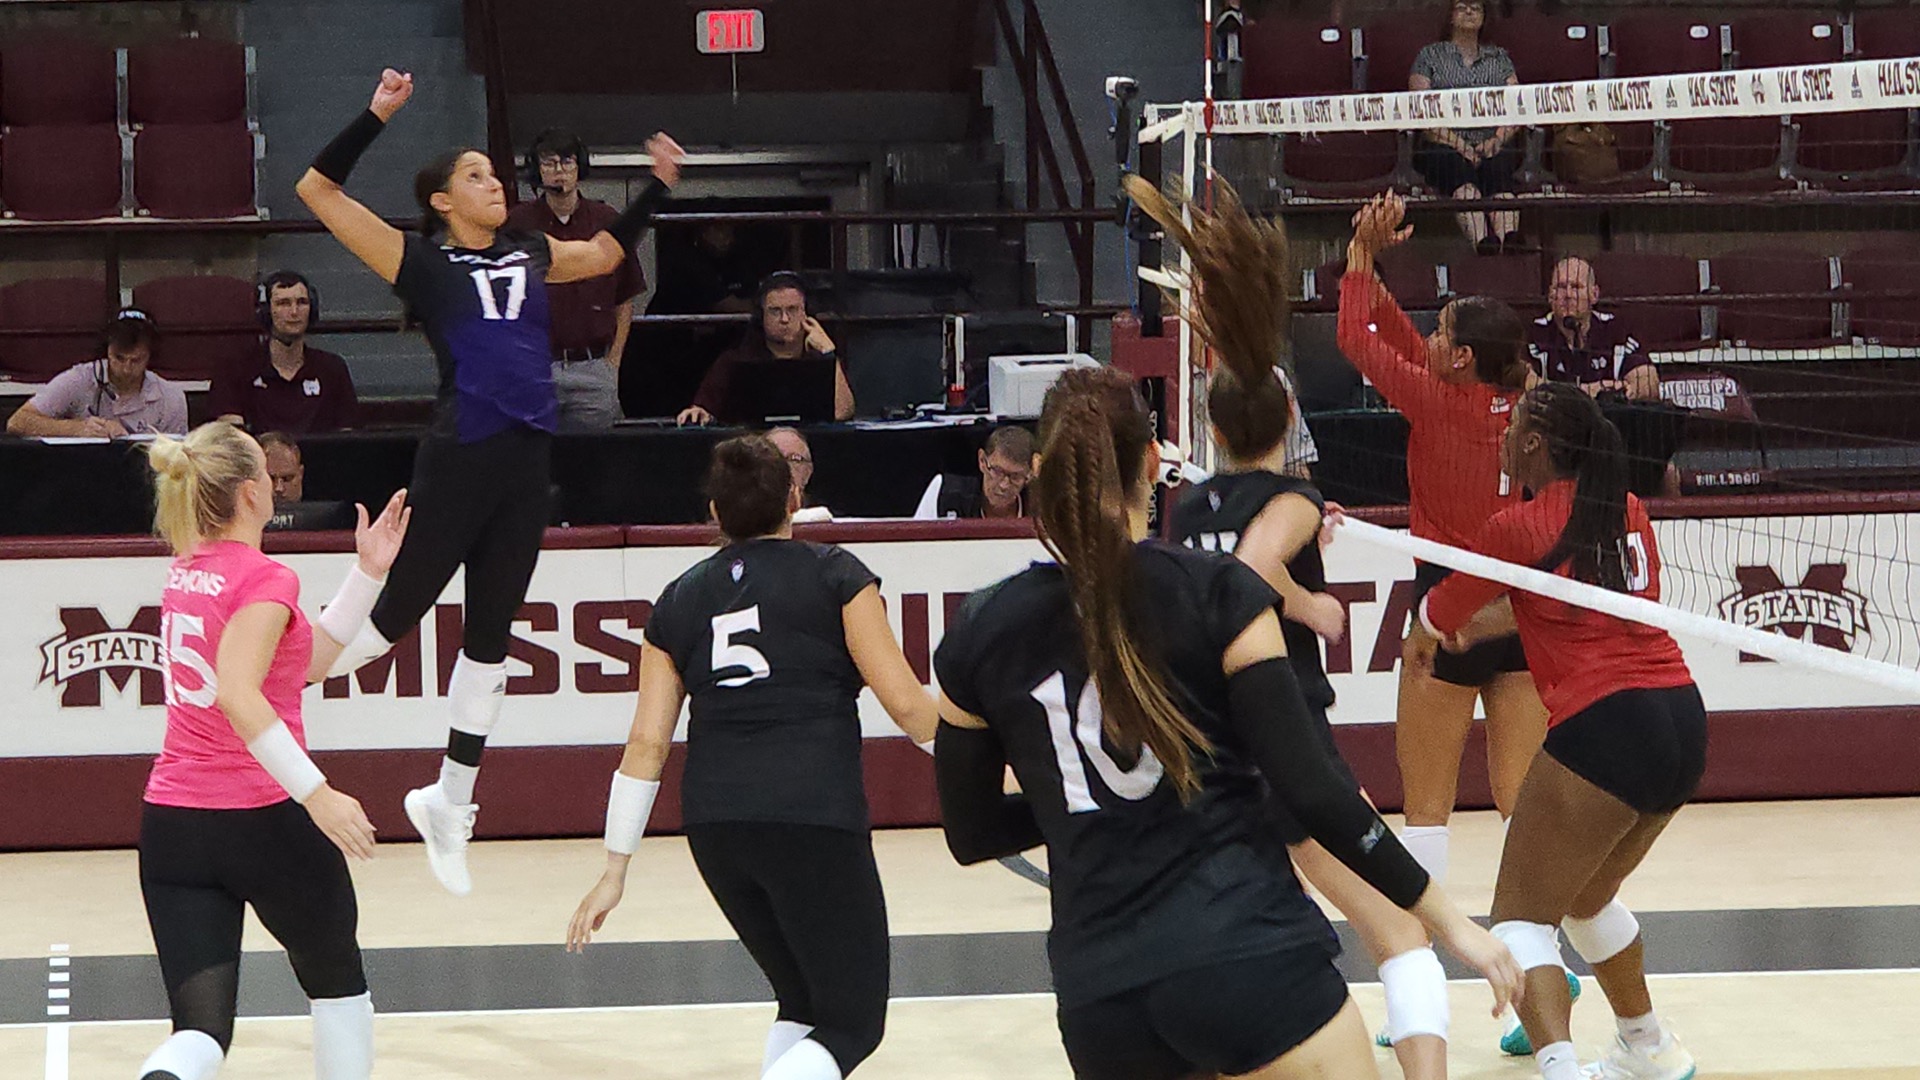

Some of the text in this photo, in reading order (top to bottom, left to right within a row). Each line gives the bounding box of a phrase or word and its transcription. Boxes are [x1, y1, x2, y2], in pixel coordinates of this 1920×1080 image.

[708, 13, 755, 50] EXIT
[468, 266, 528, 320] 17
[1744, 594, 1842, 628] STATE
[161, 611, 218, 708] 15
[711, 604, 771, 688] 5
